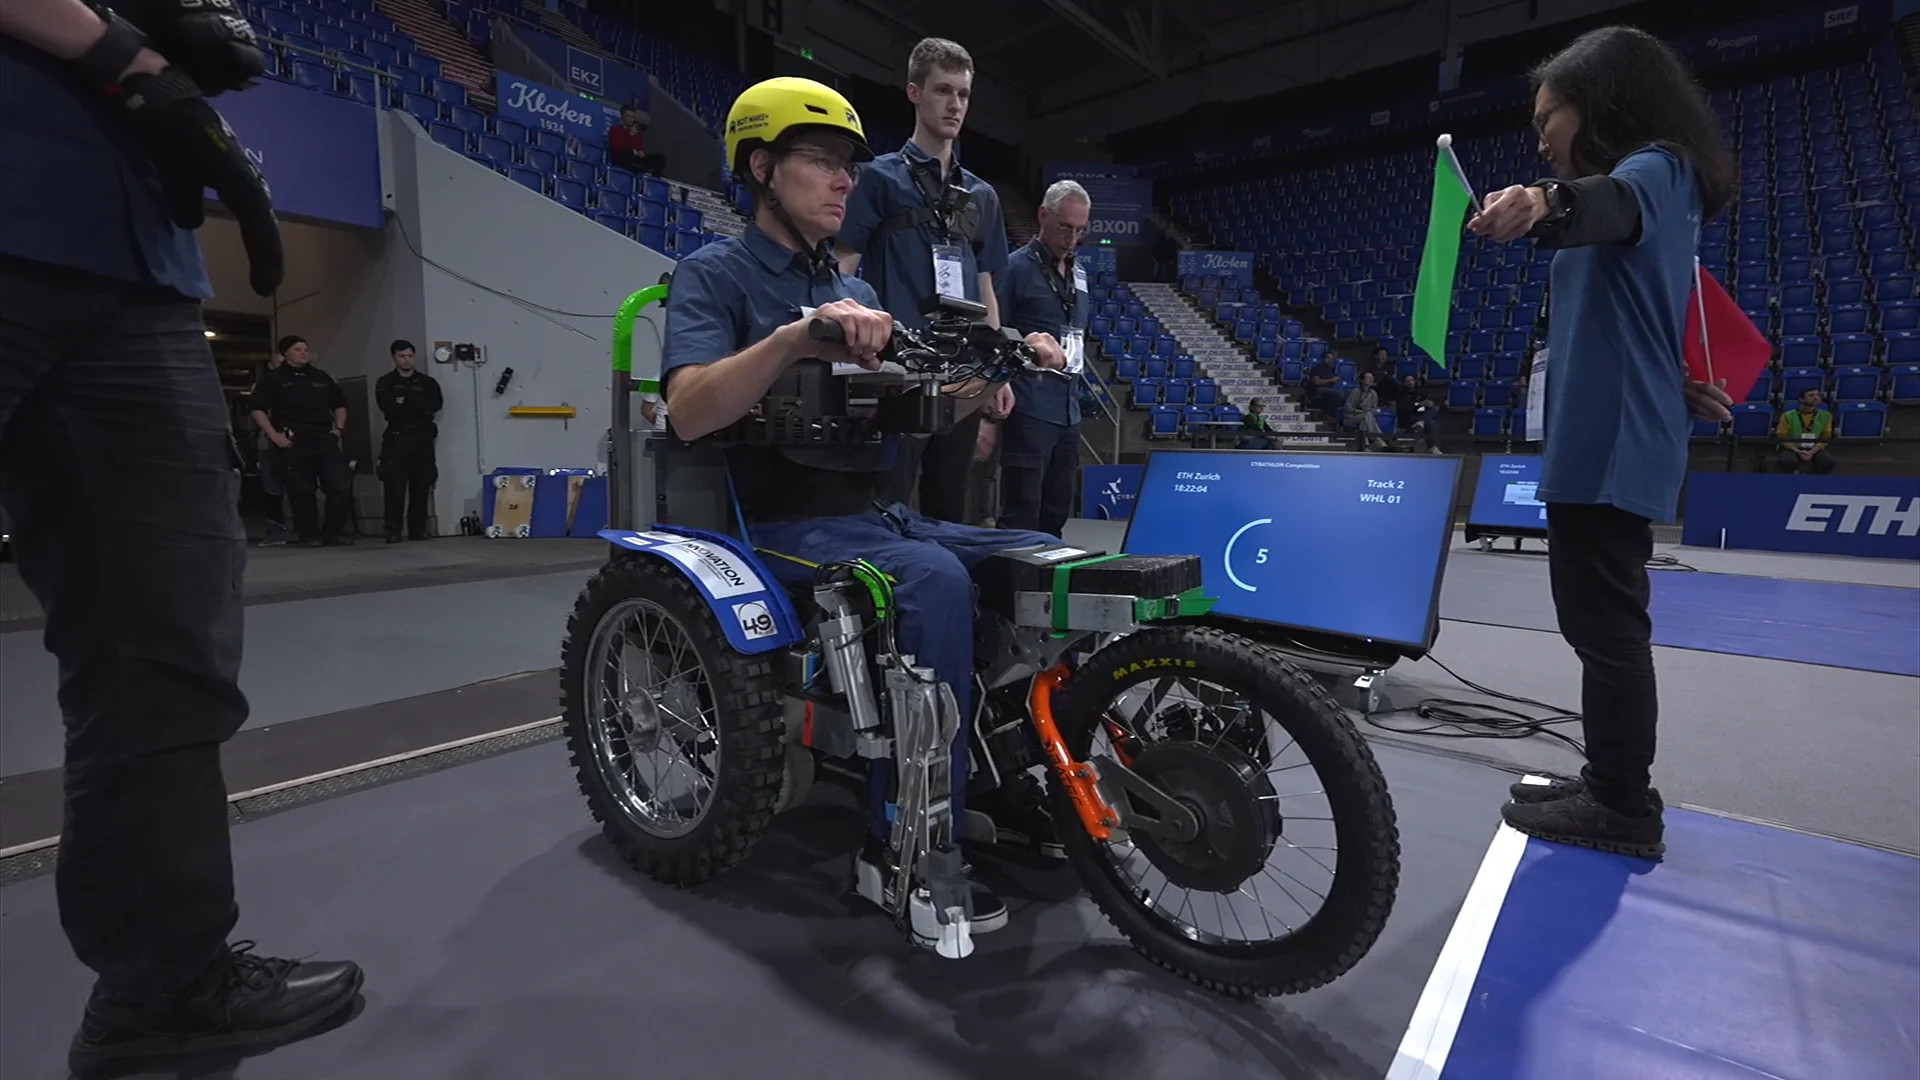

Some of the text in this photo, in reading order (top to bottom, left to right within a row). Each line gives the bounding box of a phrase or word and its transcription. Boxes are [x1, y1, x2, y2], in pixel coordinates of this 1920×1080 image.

[571, 65, 601, 88] EKZ
[507, 82, 593, 127] Kloten
[540, 117, 565, 134] 1934
[1201, 254, 1249, 270] Kloten
[1176, 472, 1221, 481] ETH Zurich
[1367, 479, 1405, 489] Track 2
[1174, 484, 1208, 493] 18:22:04
[1360, 493, 1401, 504] WHL 01
[1785, 494, 1920, 536] ETH
[1255, 548, 1269, 564] 5
[743, 613, 772, 635] 49
[1112, 658, 1197, 680] MAXXIS
